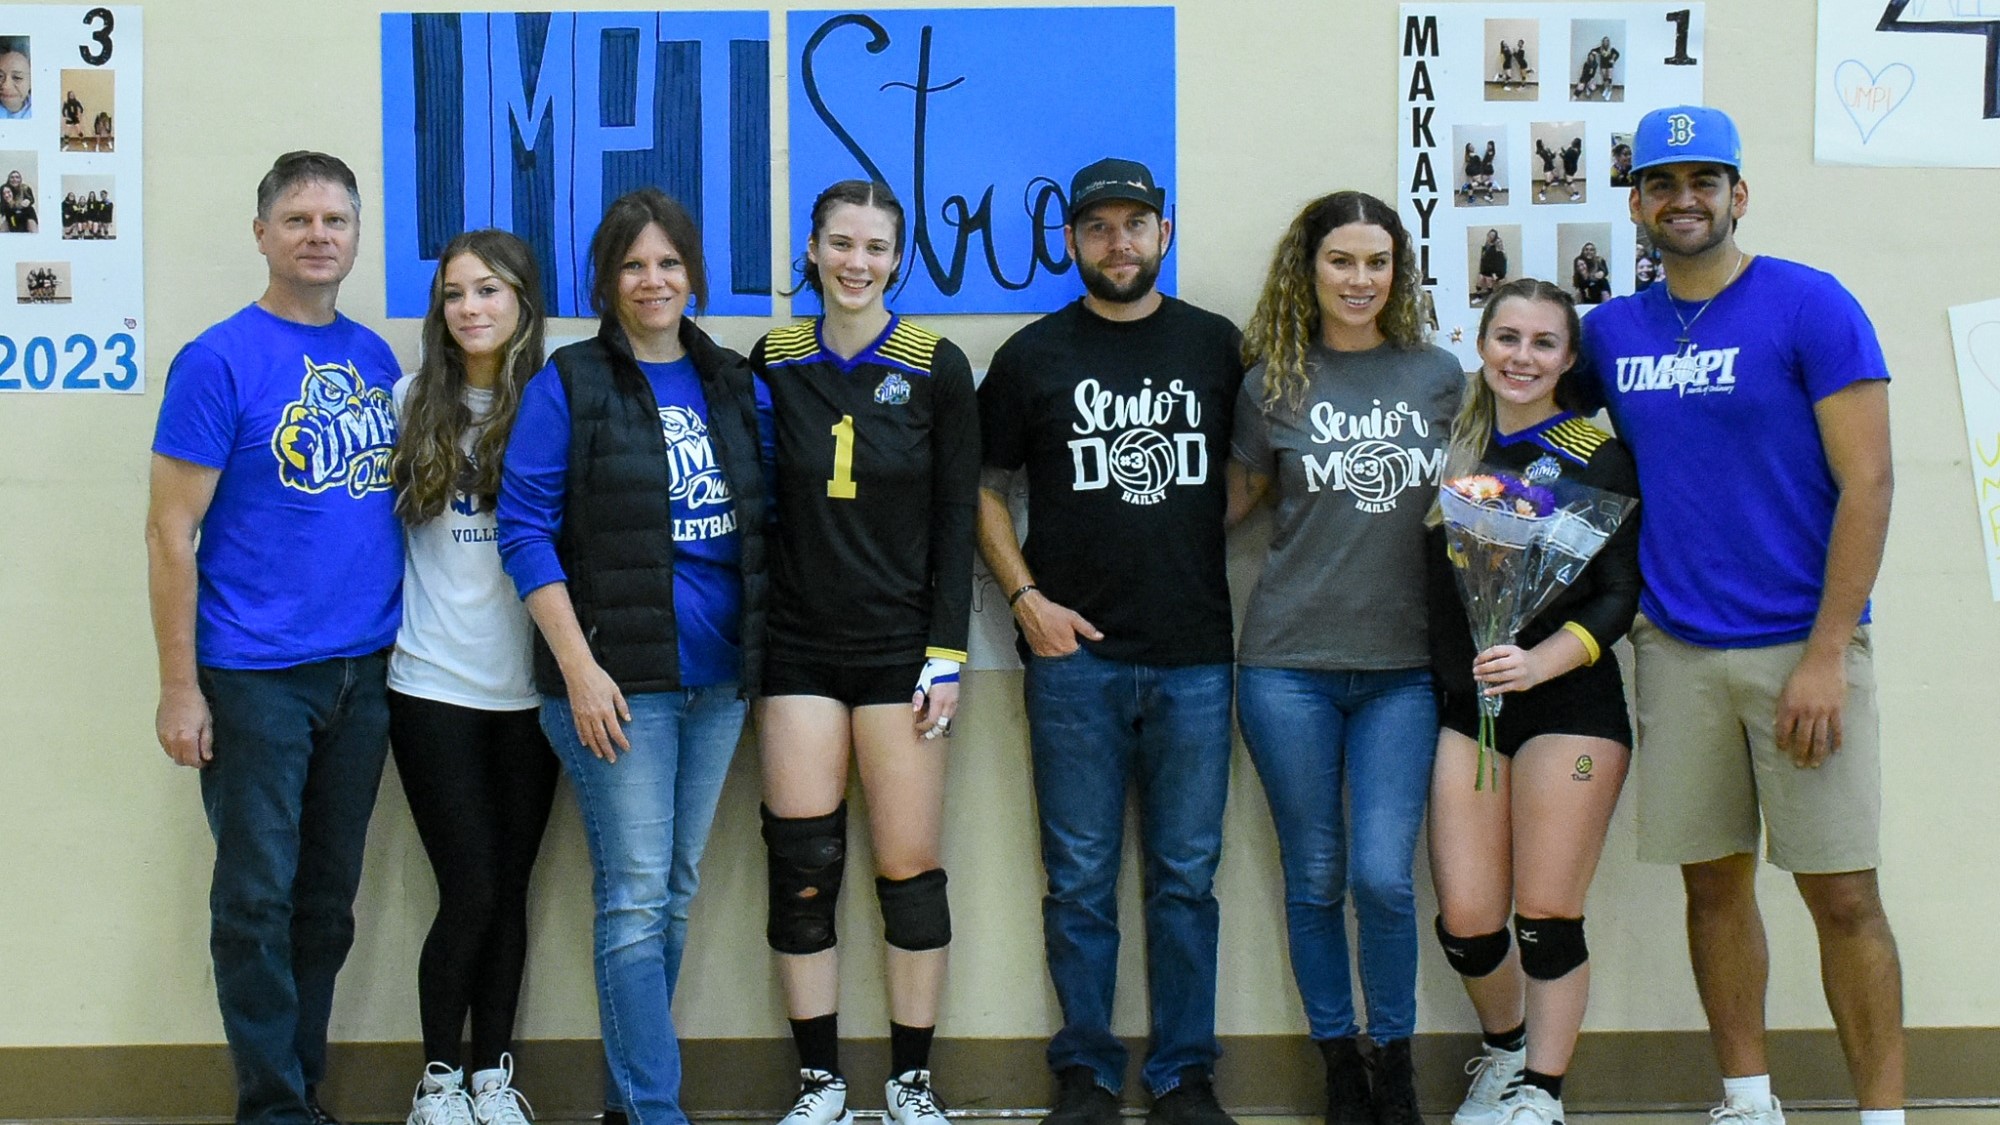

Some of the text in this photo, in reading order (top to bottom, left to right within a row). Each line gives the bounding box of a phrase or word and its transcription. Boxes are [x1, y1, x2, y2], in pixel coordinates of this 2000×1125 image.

[79, 7, 115, 66] 3
[1663, 10, 1697, 66] 1
[1844, 86, 1892, 113] UMPI
[1667, 113, 1696, 147] B
[1616, 347, 1740, 394] UMPI
[1072, 377, 1201, 435] Senior
[1310, 398, 1429, 444] Senior
[827, 414, 857, 499] 1
[1119, 452, 1144, 469] #3
[1353, 460, 1379, 476] #3
[1121, 489, 1167, 505] HAILEY
[1355, 499, 1397, 513] HAILEY
[671, 510, 738, 542] LEYBA
